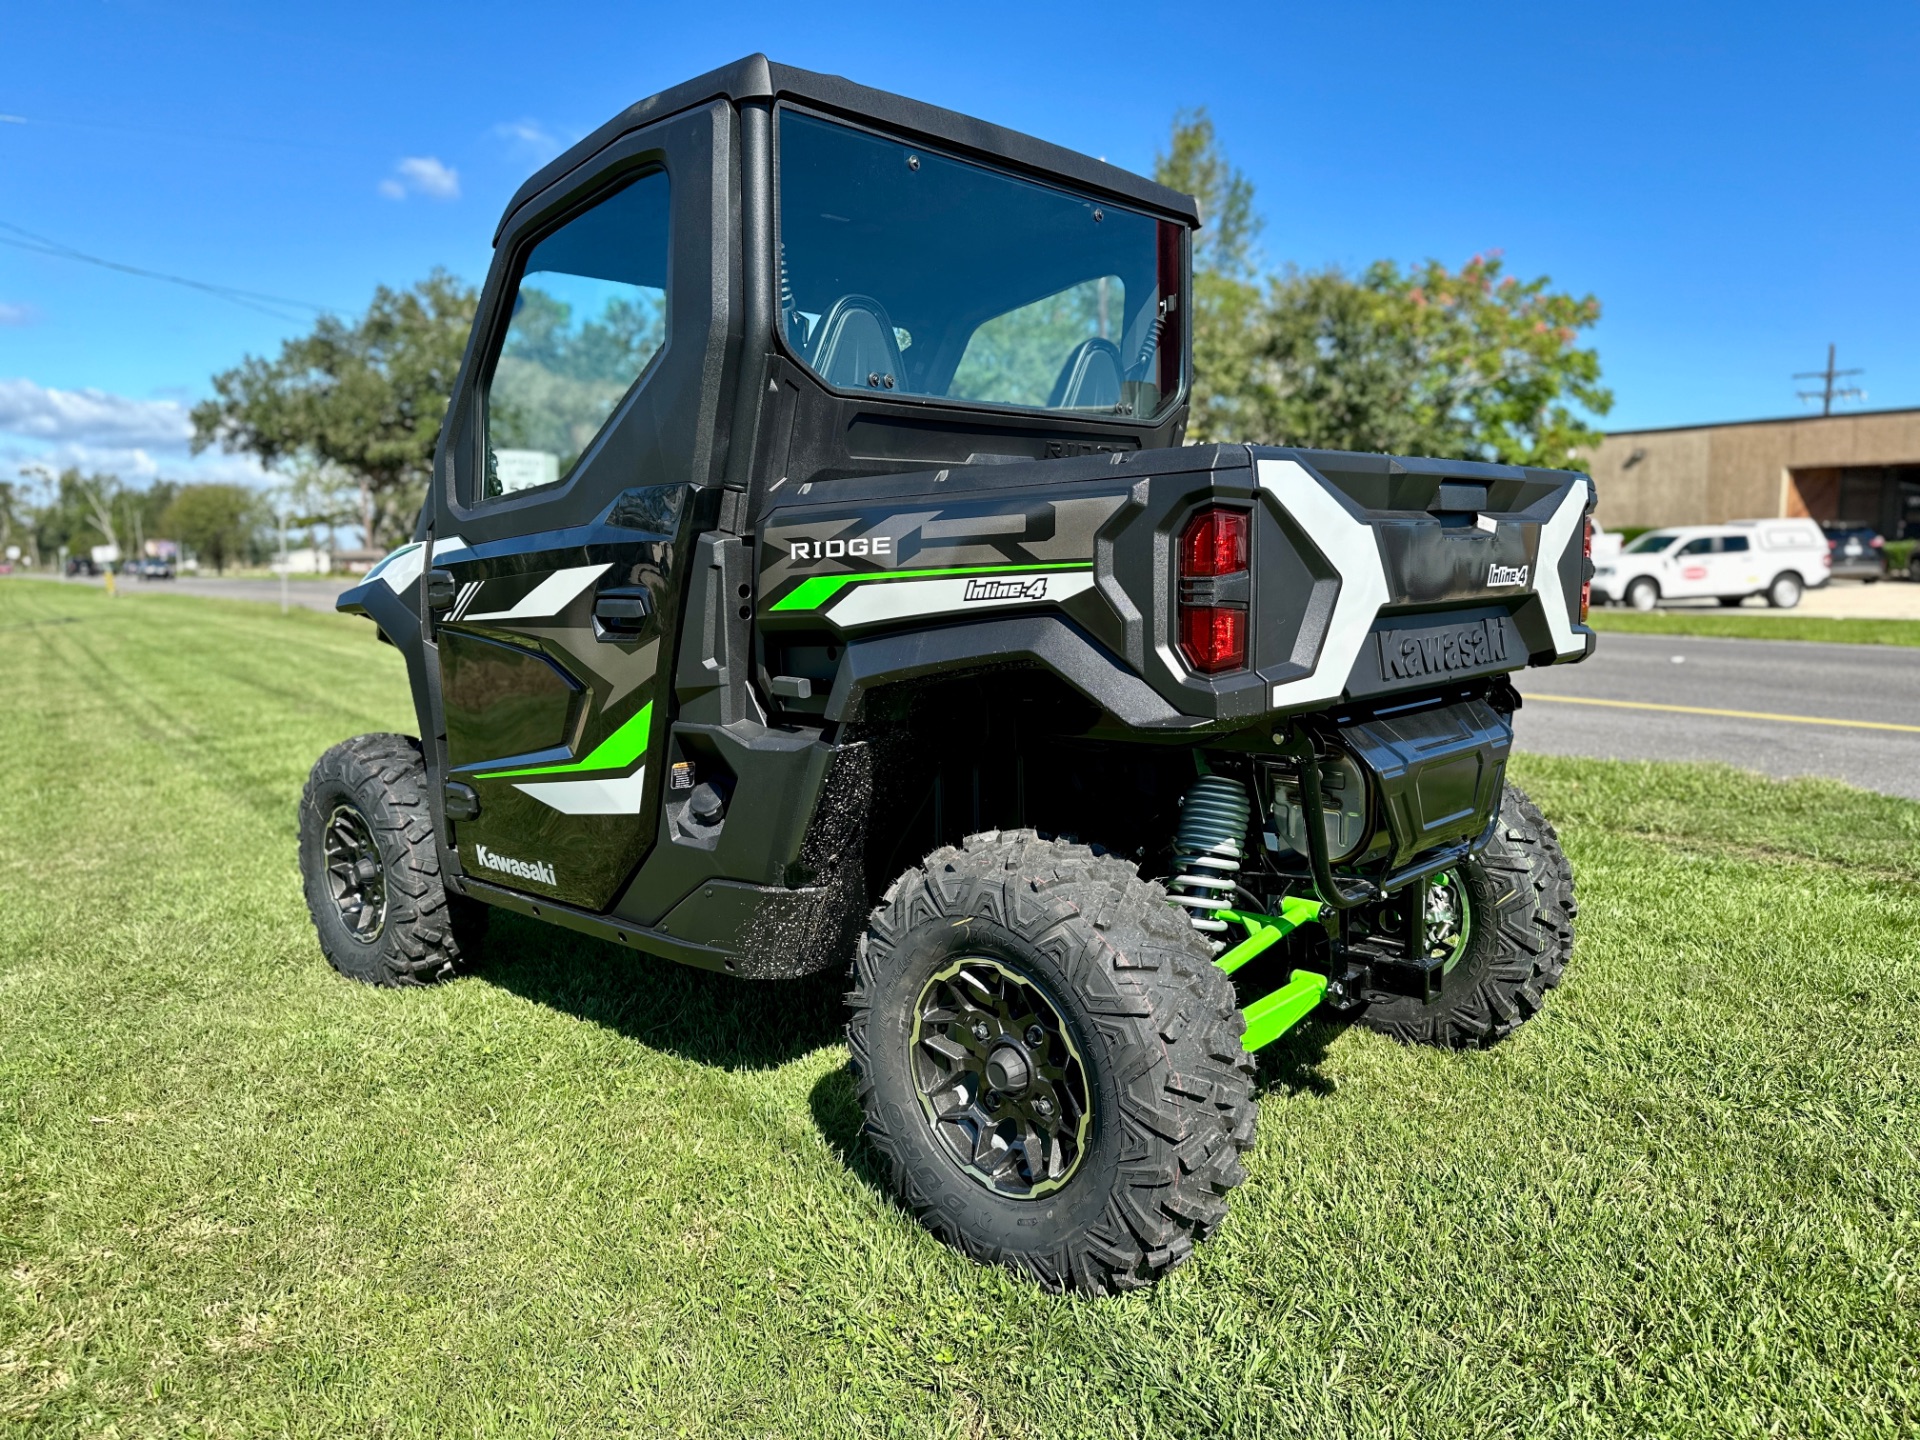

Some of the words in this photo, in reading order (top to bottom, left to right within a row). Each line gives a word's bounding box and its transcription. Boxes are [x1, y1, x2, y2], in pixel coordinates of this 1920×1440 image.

[1044, 441, 1131, 459] RID
[790, 536, 892, 560] RIDGE
[1487, 563, 1529, 587] Inline-4
[963, 577, 1048, 601] Inline-4
[1376, 616, 1508, 682] Kawasaki
[475, 843, 557, 886] Kawasaki
[884, 1103, 970, 1216] DURO
